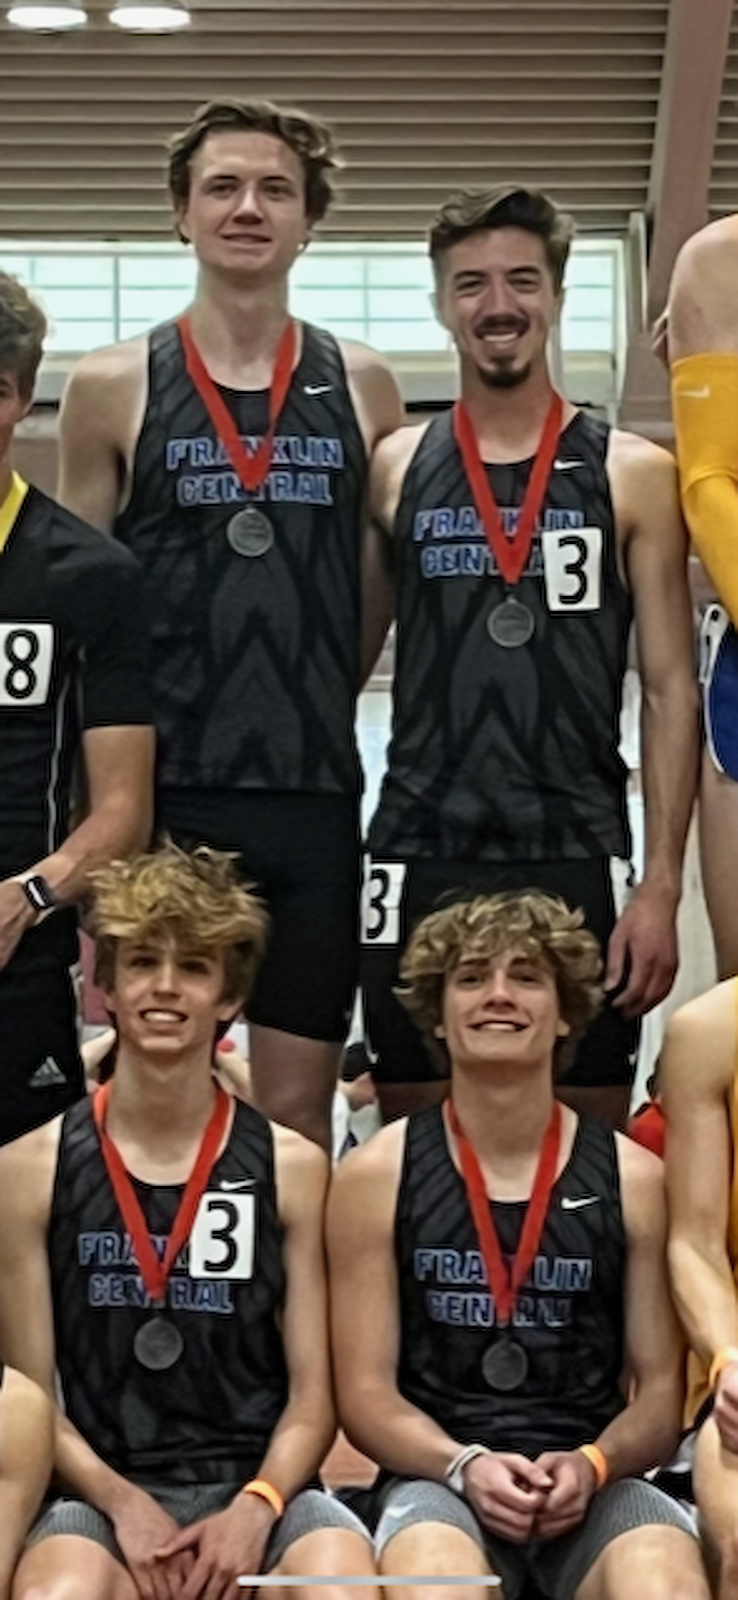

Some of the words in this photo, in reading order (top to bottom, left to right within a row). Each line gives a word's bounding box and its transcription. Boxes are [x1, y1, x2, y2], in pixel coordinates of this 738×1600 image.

[177, 471, 334, 506] CENRAL
[413, 506, 585, 542] FRAKIN
[421, 543, 545, 579] CENA
[557, 536, 589, 605] 3
[4, 628, 40, 700] 8
[366, 868, 391, 940] 3
[202, 1199, 241, 1273] 3
[414, 1249, 592, 1291] FRALIN
[89, 1273, 235, 1314] CENRAL
[427, 1290, 573, 1328] CENRAL
